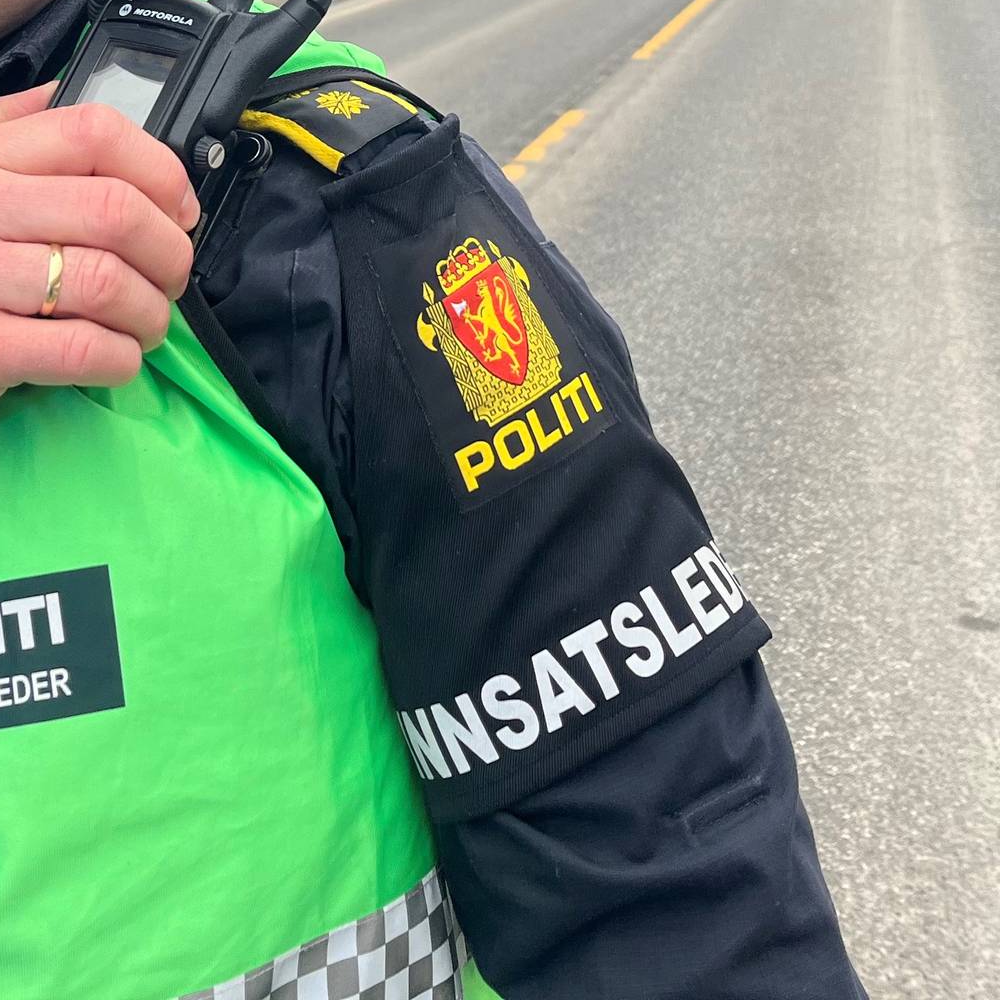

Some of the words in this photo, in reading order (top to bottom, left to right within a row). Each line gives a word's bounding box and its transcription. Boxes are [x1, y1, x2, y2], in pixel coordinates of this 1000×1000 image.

[133, 8, 193, 26] MOTOROLA
[454, 372, 603, 493] POLITI
[397, 540, 749, 780] INNSATSLED
